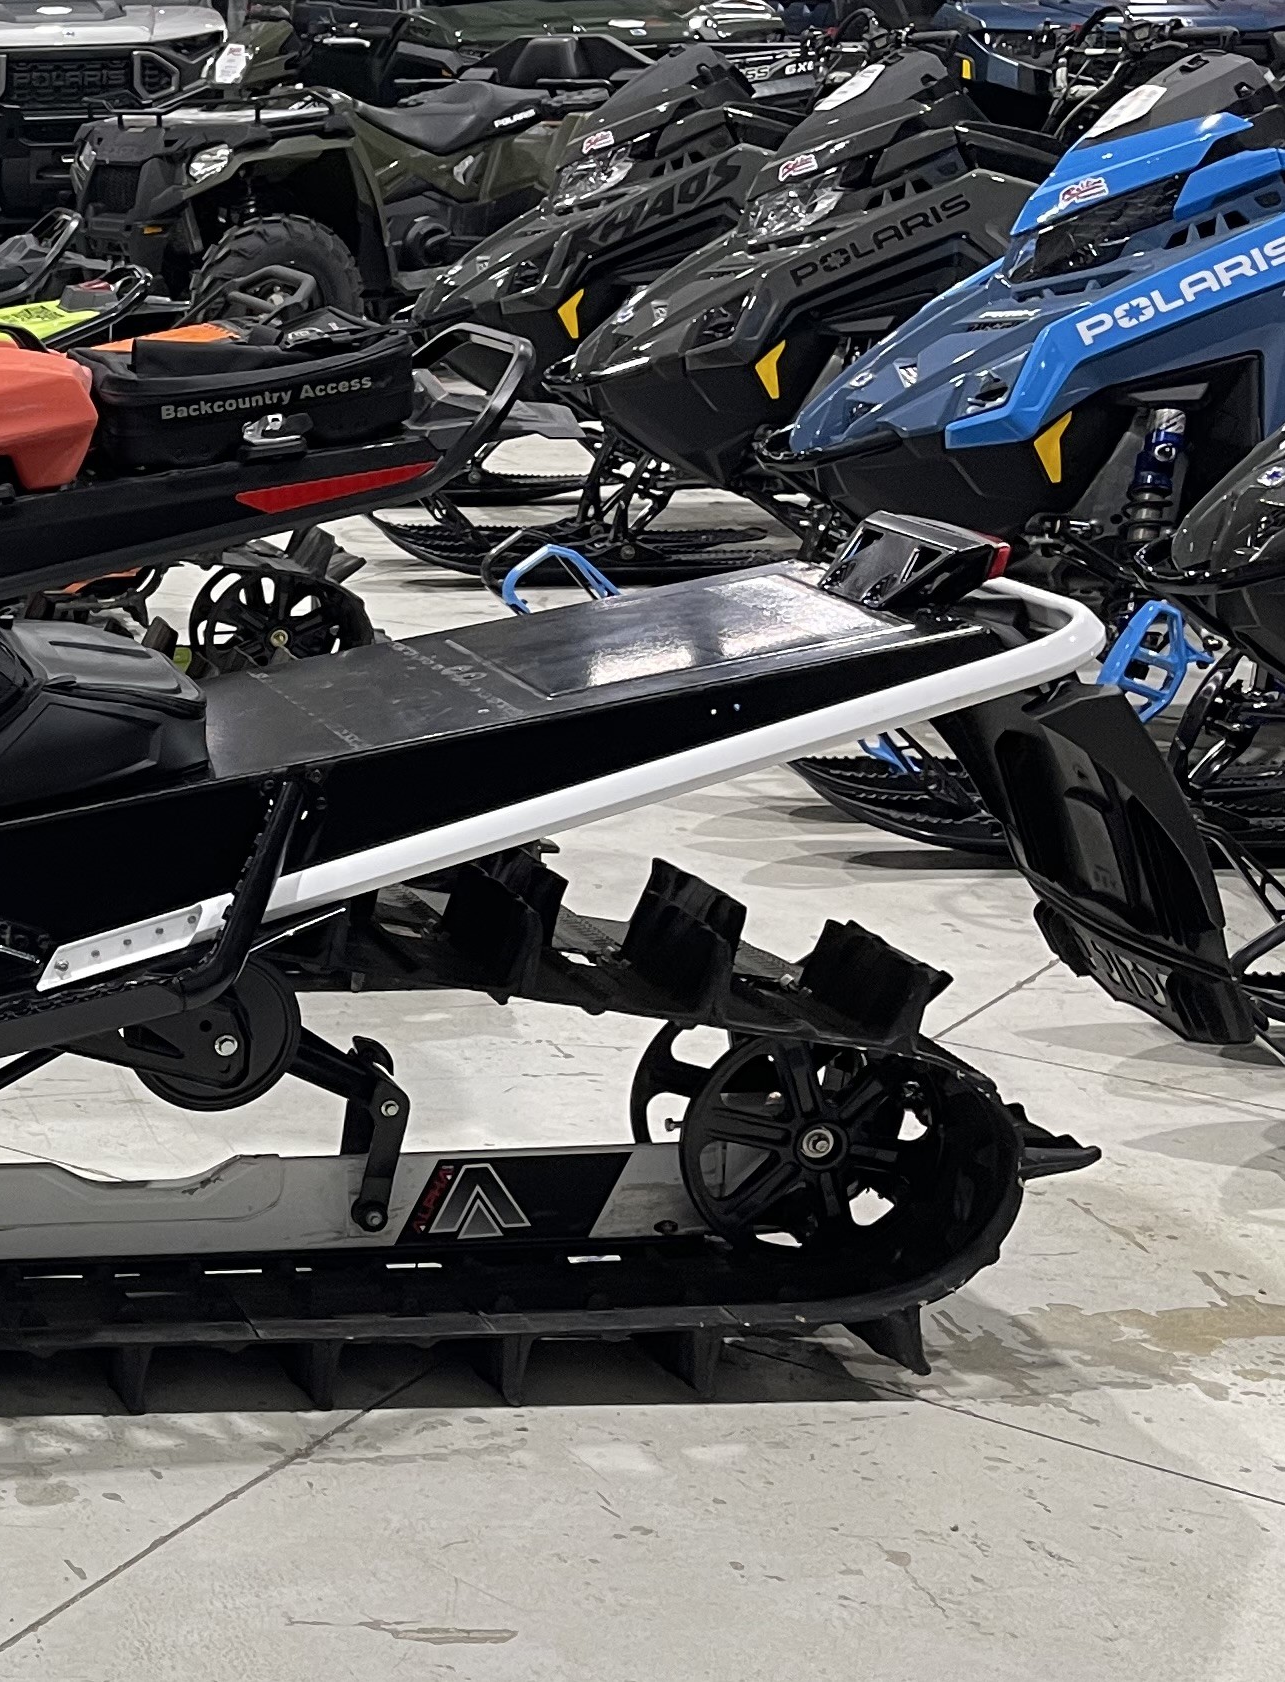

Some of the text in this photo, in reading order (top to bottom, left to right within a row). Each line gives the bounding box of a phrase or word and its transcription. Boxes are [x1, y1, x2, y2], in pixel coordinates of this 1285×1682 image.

[12, 69, 126, 88] POLARIS
[789, 193, 971, 288] POLARIS
[1075, 235, 1285, 347] POLARIS
[160, 376, 372, 420] Backcountry Access
